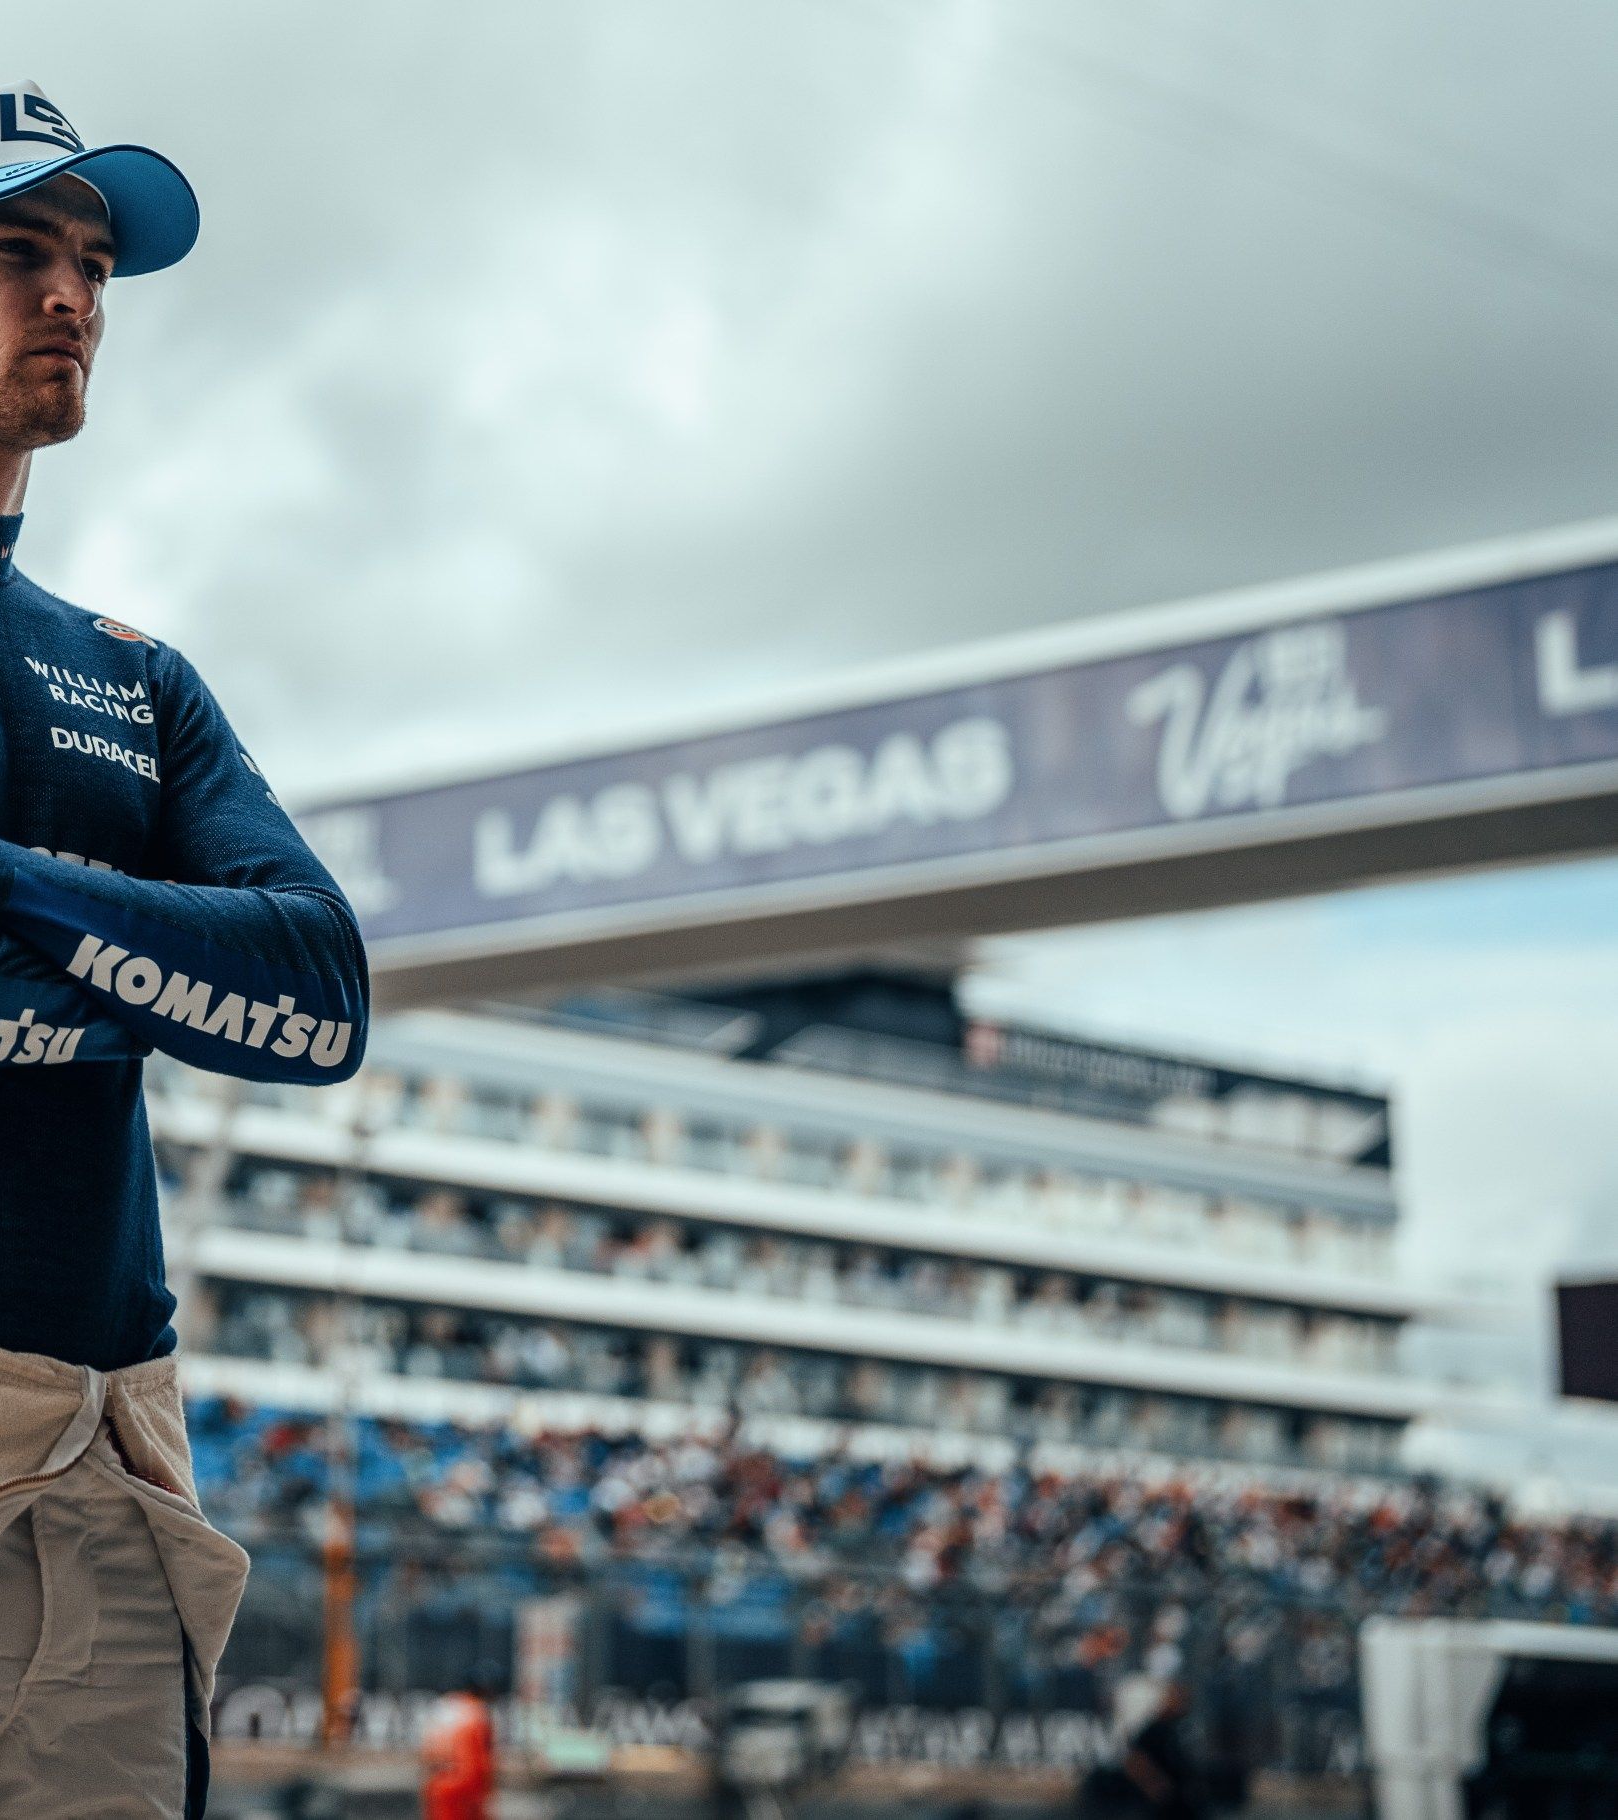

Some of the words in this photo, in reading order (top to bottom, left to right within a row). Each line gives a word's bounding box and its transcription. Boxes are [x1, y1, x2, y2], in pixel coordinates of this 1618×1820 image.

[24, 656, 146, 702] WILLIAM
[48, 683, 154, 724] RACING
[50, 726, 161, 784] DURACEL
[473, 780, 663, 898] LAS
[662, 714, 1016, 866] VEGAS
[66, 933, 352, 1067] KOMATSU
